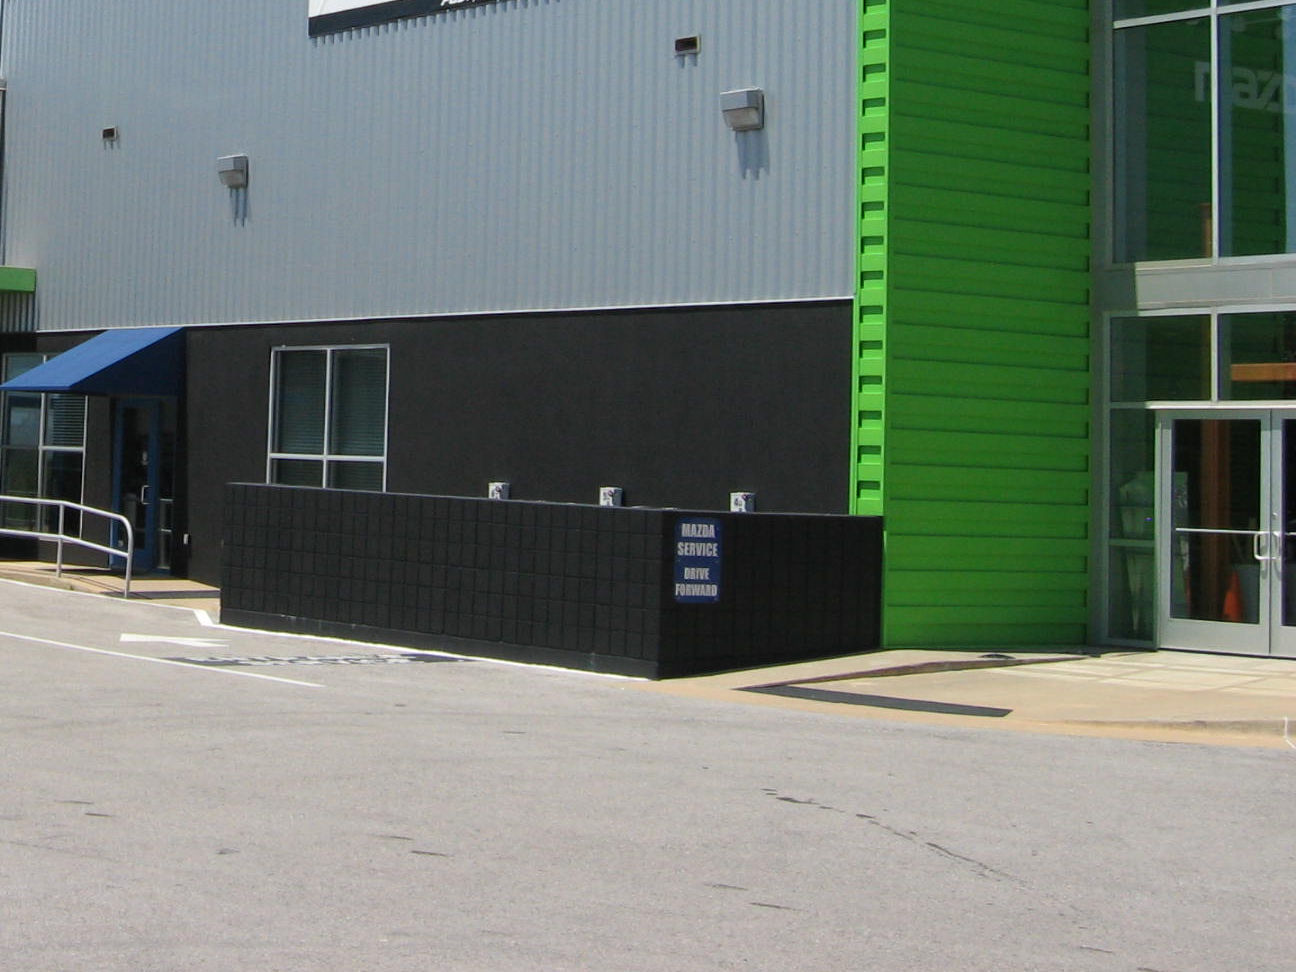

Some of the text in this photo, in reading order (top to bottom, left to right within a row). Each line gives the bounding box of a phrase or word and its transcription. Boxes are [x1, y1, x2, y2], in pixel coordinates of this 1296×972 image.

[681, 523, 716, 538] MAZDA
[677, 542, 719, 557] SERVICE
[684, 567, 710, 580] DRIVE
[675, 583, 718, 597] FORWARD
